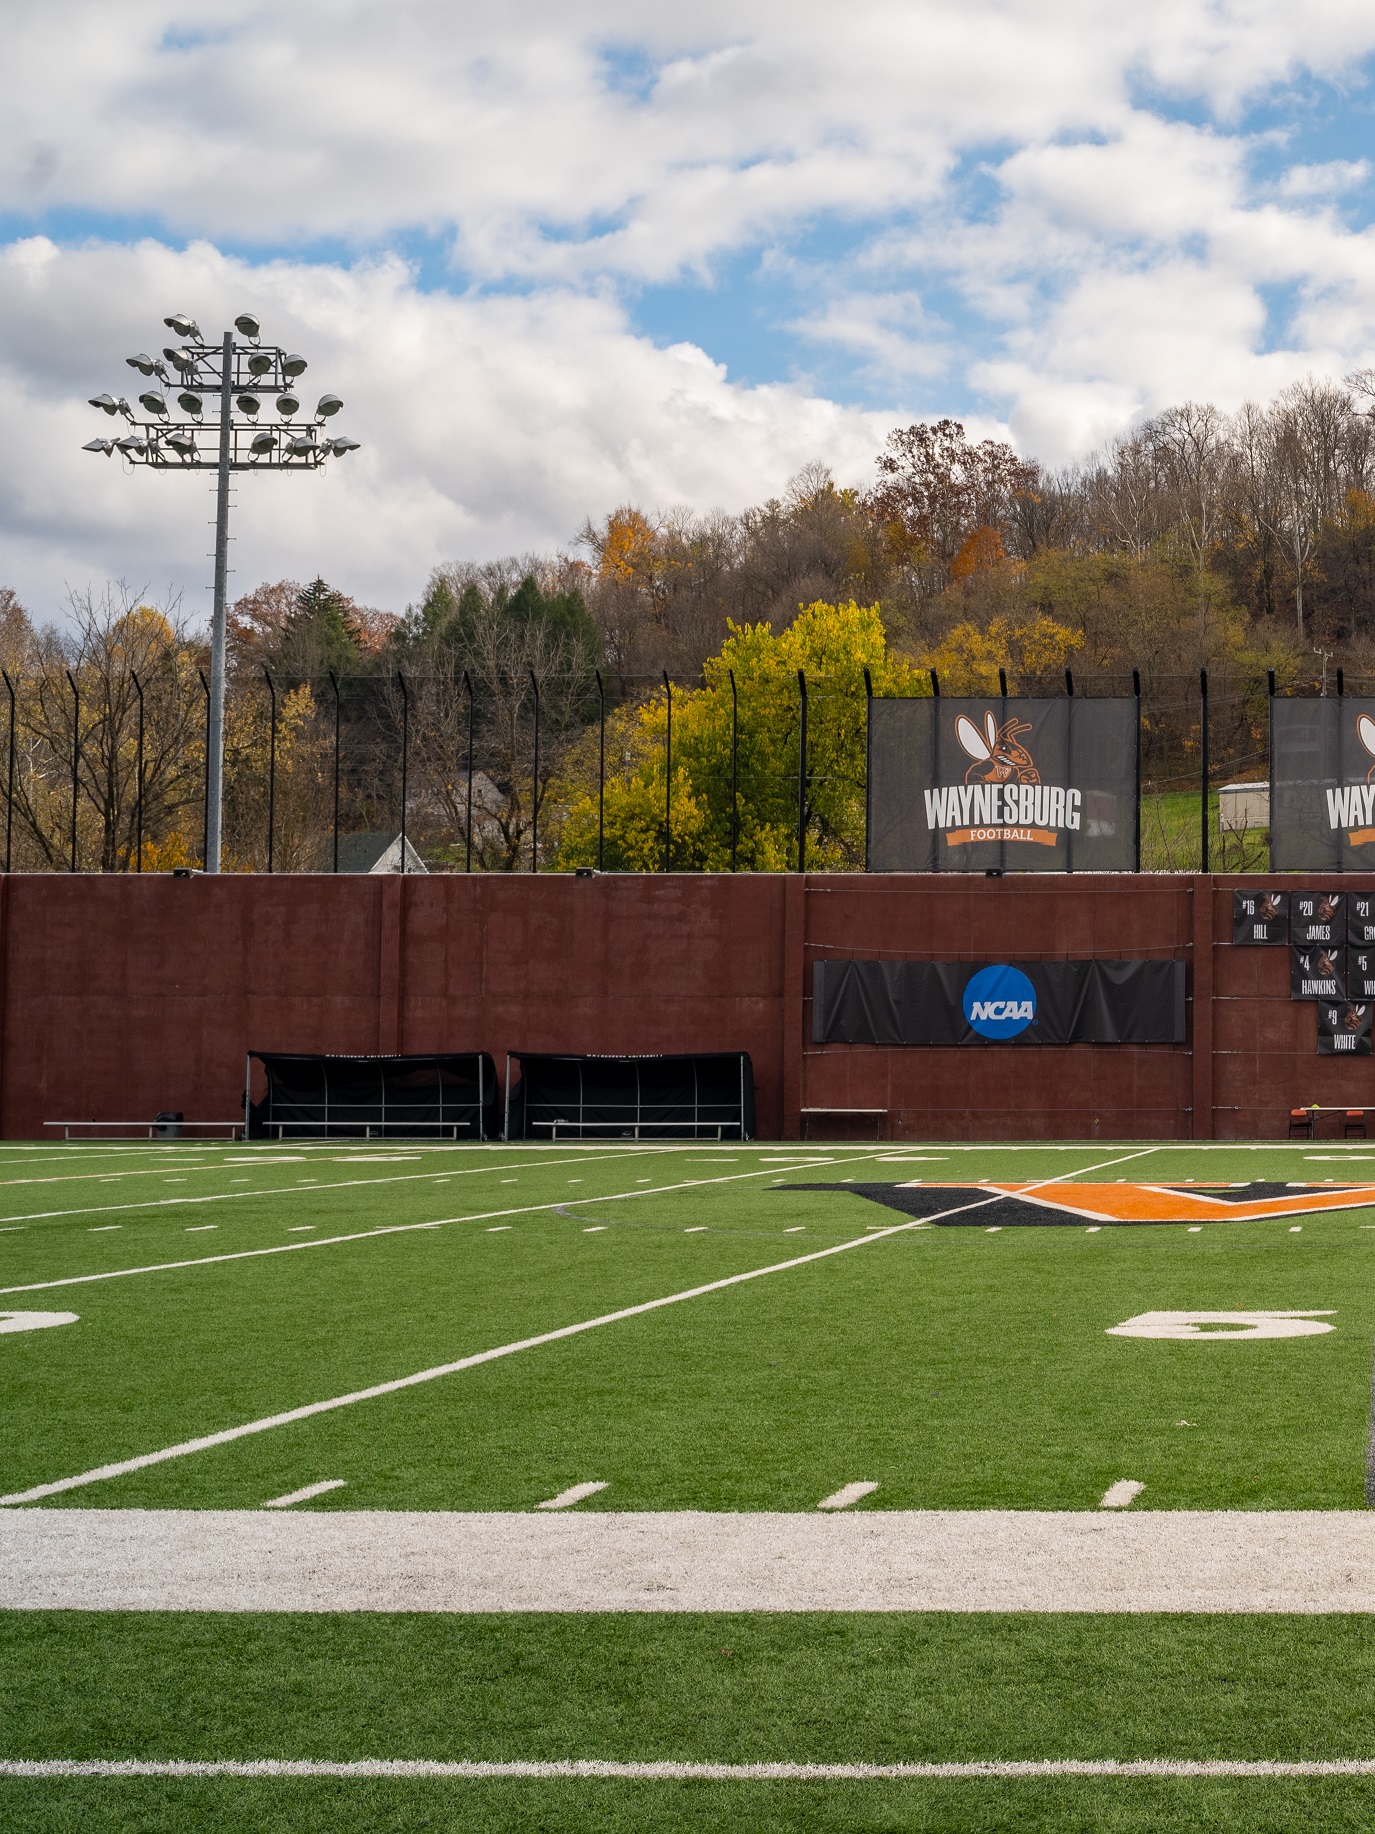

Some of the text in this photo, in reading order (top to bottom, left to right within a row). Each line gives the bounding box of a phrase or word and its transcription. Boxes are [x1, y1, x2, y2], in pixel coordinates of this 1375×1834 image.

[924, 783, 1082, 831] WAYNESBURG
[970, 829, 1034, 841] FOOTBALL
[1242, 899, 1255, 915] #16
[1299, 900, 1313, 916] #20
[1356, 901, 1369, 917] #21
[1253, 924, 1268, 939] HILL
[1306, 925, 1331, 940] JAMES
[1299, 955, 1310, 971] #4
[1357, 955, 1367, 971] #5
[1301, 979, 1336, 995] HAWKINS
[970, 1001, 1034, 1021] NCAA
[1328, 1010, 1338, 1025] #9
[1333, 1034, 1356, 1050] WHITE
